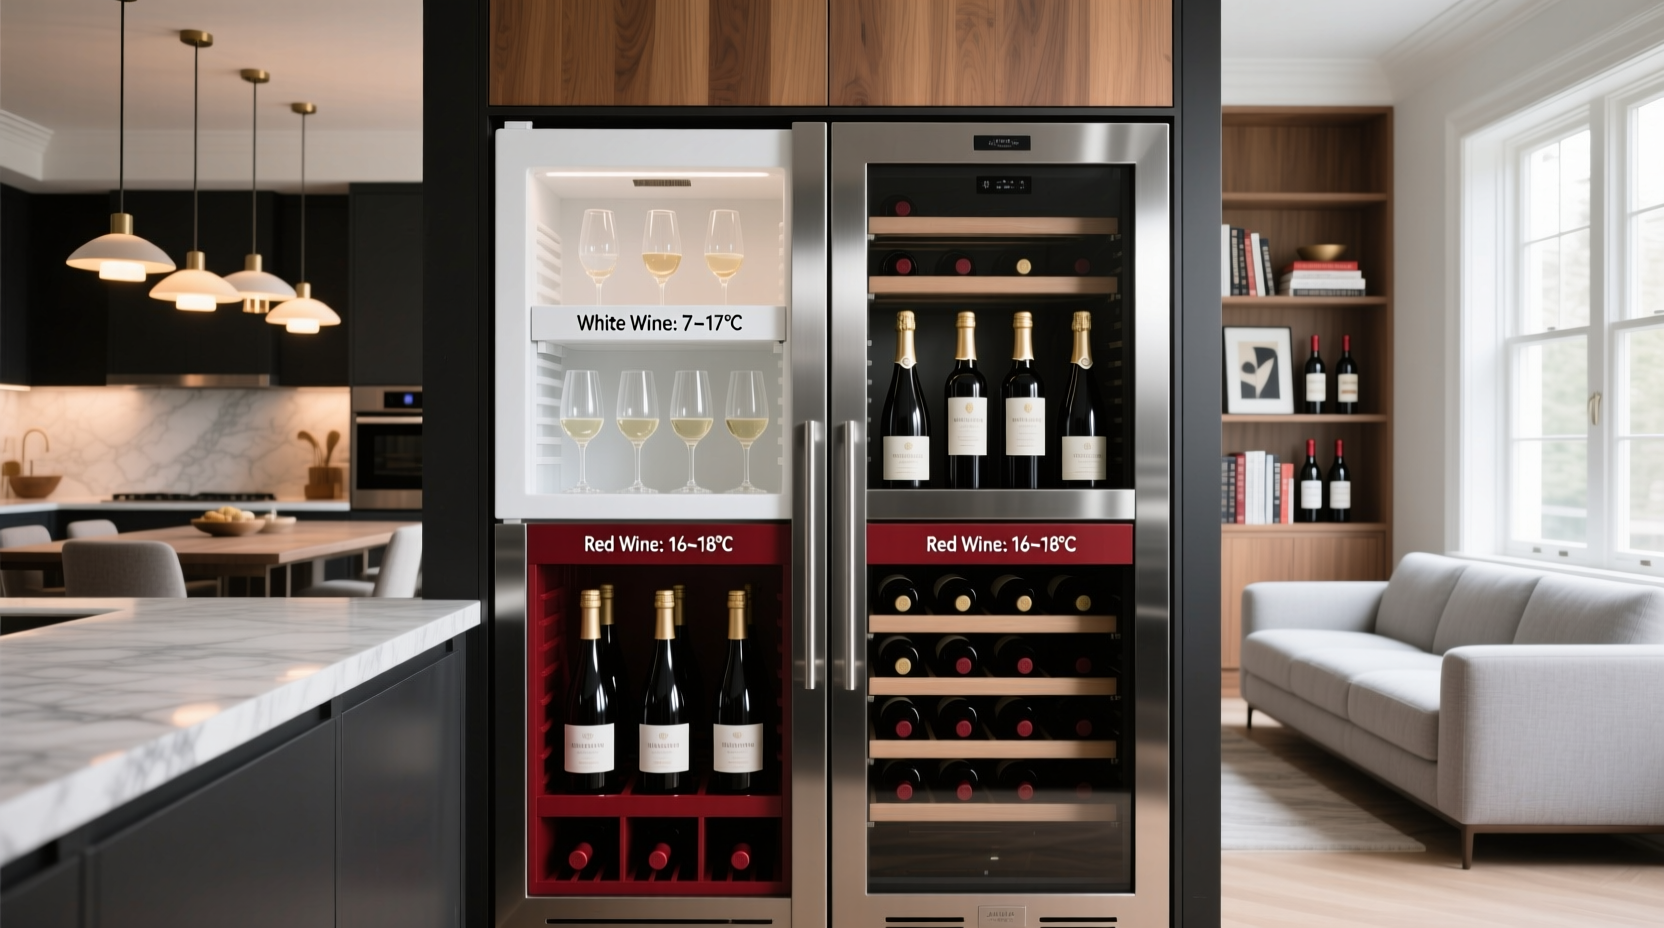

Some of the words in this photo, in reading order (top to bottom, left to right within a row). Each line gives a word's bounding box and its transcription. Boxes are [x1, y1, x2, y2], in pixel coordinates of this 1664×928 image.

[576, 313, 626, 332] White
[630, 314, 678, 332] Wine:
[584, 534, 615, 553] Red
[618, 535, 664, 553] Wine:
[926, 534, 957, 553] Red
[961, 535, 1008, 553] Wine:
